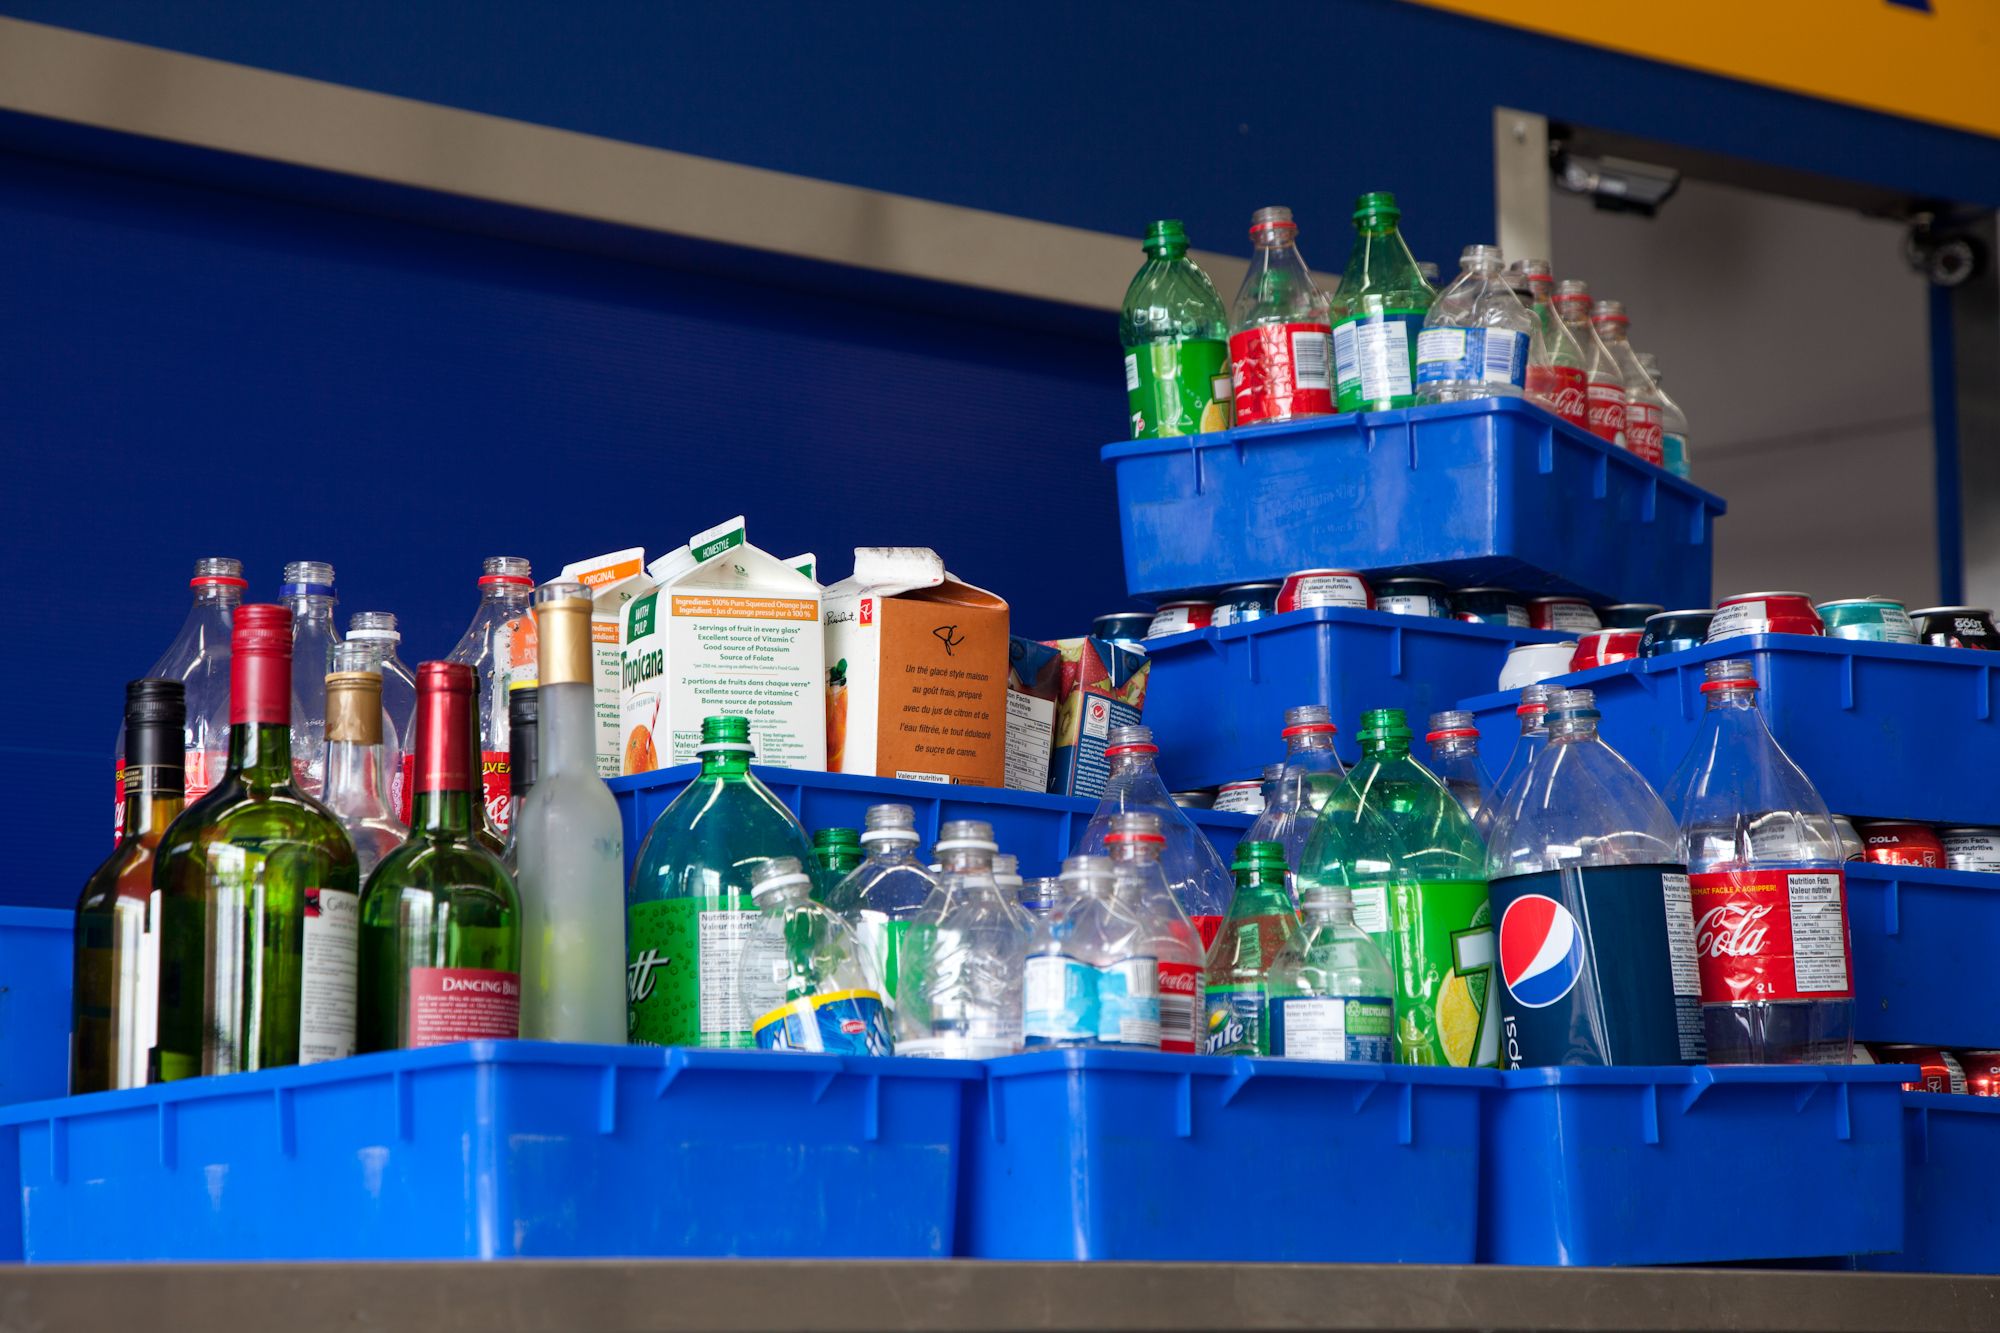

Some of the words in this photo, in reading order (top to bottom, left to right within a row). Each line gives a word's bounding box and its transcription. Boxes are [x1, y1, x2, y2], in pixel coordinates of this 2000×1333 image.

[702, 538, 730, 559] HOMESTYLE
[584, 569, 616, 586] ORIGINAL
[675, 598, 710, 606] Ingredient:
[745, 601, 776, 609] Squeezed
[776, 602, 799, 610] Orange
[635, 603, 650, 620] WITH
[634, 620, 648, 637] PULP
[699, 624, 728, 632] servings
[697, 633, 728, 641] Excellent
[703, 643, 723, 651] Good
[755, 645, 790, 653] Potassium
[720, 653, 743, 661] Source
[601, 659, 620, 667] Excelle
[620, 648, 664, 693] Tropicana
[905, 664, 915, 673] Un
[917, 665, 929, 675] thé
[929, 667, 948, 677] glacé
[949, 668, 965, 680] style
[965, 671, 989, 681] maison
[687, 678, 717, 686] portions
[765, 680, 789, 688] chaque
[694, 687, 730, 695] Excellente
[763, 689, 793, 697] vitamine
[912, 686, 922, 694] au
[923, 685, 939, 696] goût
[939, 687, 957, 698] frais,
[957, 689, 983, 701] préparé
[636, 697, 656, 710] PREMIUM
[701, 697, 723, 705] Bonne
[758, 699, 793, 707] potassium
[1015, 694, 1031, 705] Facts
[720, 707, 744, 715] Source
[1009, 701, 1032, 712] nutritive
[597, 711, 620, 719] Excellen
[903, 704, 920, 713] avec
[921, 705, 931, 714] du
[931, 706, 943, 717] jus
[944, 707, 953, 716] de
[954, 708, 973, 718] citron
[973, 710, 981, 719] et
[981, 711, 990, 720] de
[900, 722, 918, 732] l'eau
[942, 726, 949, 735] le
[950, 727, 964, 737] tout
[674, 733, 703, 741] Nutritio
[675, 741, 699, 749] Valeur
[914, 743, 924, 753] de
[925, 745, 945, 754] sucre
[946, 746, 955, 755] de
[897, 772, 917, 780] Valeur
[918, 774, 944, 782] nutritive
[1868, 836, 1900, 844] COLA
[1946, 844, 1962, 852] leur
[1663, 875, 1684, 884] Nutrition
[1789, 876, 1816, 885] Nutrition
[1817, 877, 1829, 885] Facts
[1664, 884, 1680, 892] Valeur
[1691, 887, 1711, 896] ORMAT
[1711, 886, 1734, 895] FACILE
[1742, 884, 1777, 893] AGRIPPER!
[1790, 886, 1811, 894] Valeur
[1811, 886, 1832, 894] nutritive
[442, 976, 502, 994] DANCING
[1755, 983, 1765, 994] 2
[1768, 983, 1776, 994] L
